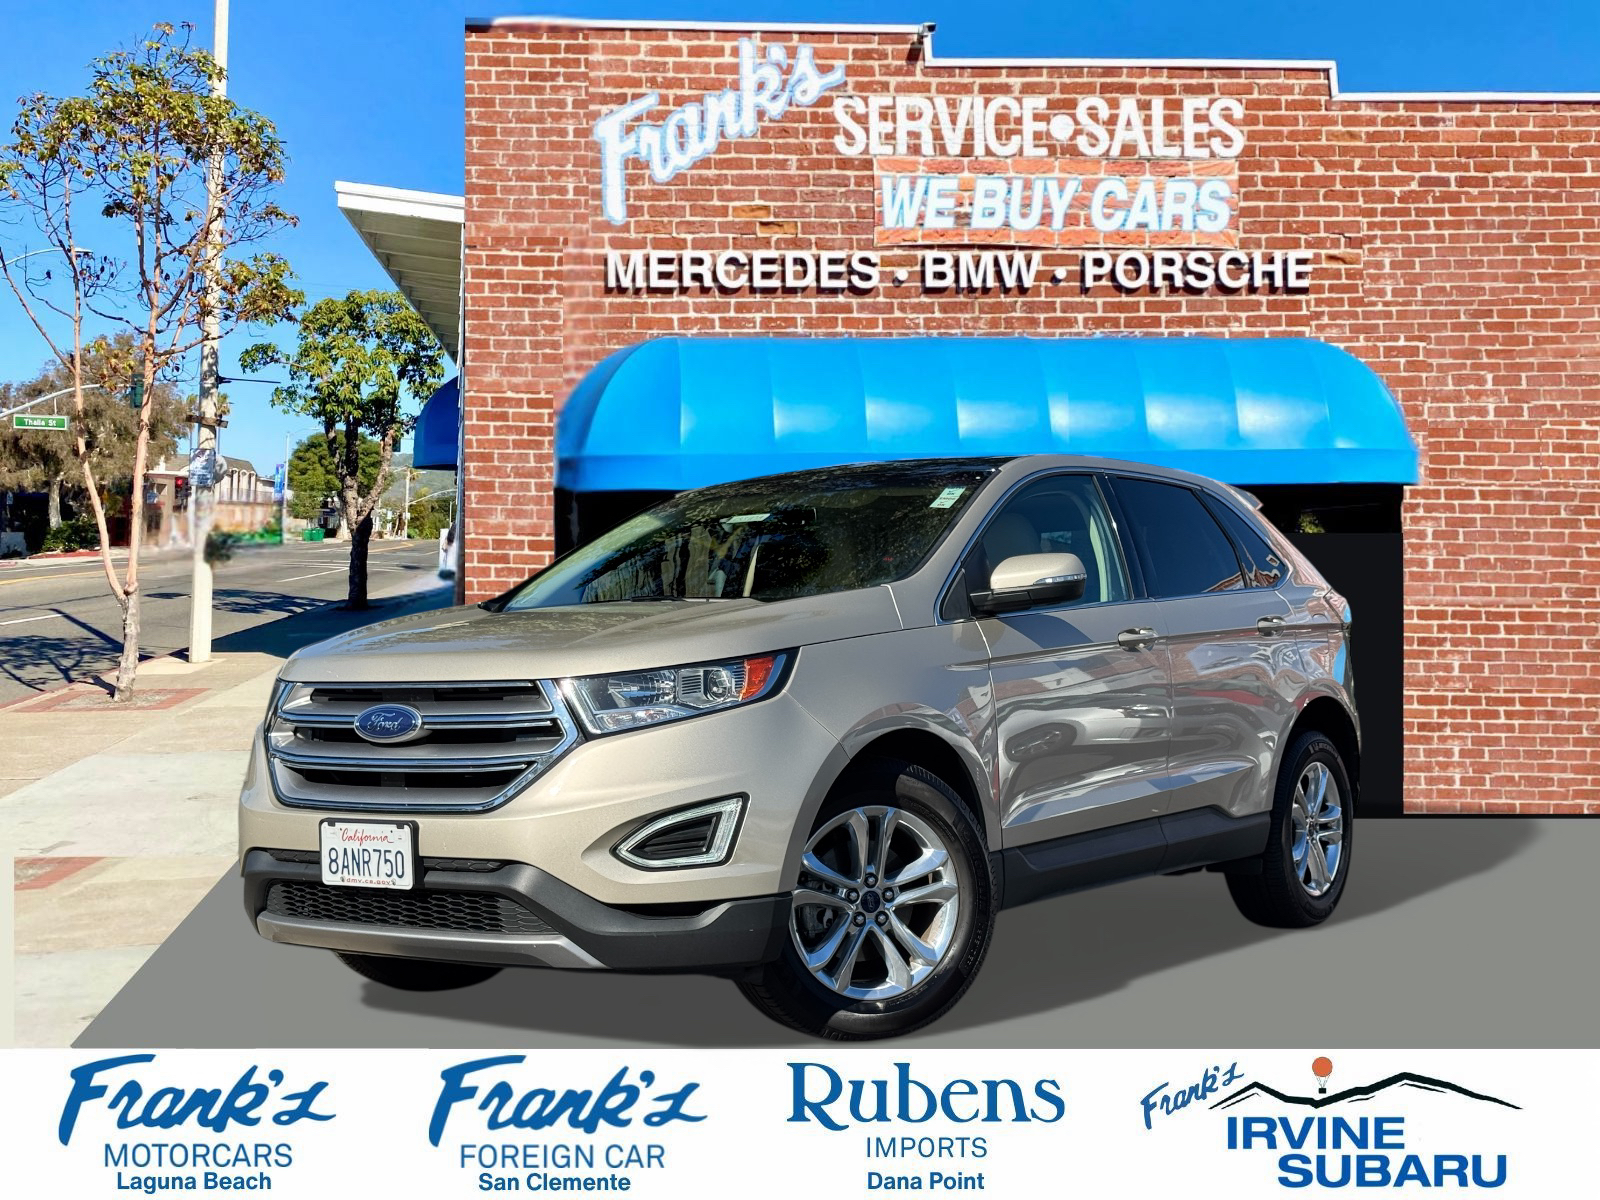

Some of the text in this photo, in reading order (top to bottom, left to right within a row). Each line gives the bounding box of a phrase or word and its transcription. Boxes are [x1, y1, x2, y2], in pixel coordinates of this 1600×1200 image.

[594, 37, 846, 226] Frank's
[833, 96, 1245, 157] SERVICE SALES
[880, 176, 1233, 233] WE BUY CARS
[606, 250, 1313, 289] MERCEDES BMW PORSCHE
[48, 419, 57, 427] St
[367, 712, 403, 732] Ford
[341, 827, 394, 847] California
[328, 847, 405, 879] 8ANR750
[346, 877, 391, 886] dmv.ca.gov
